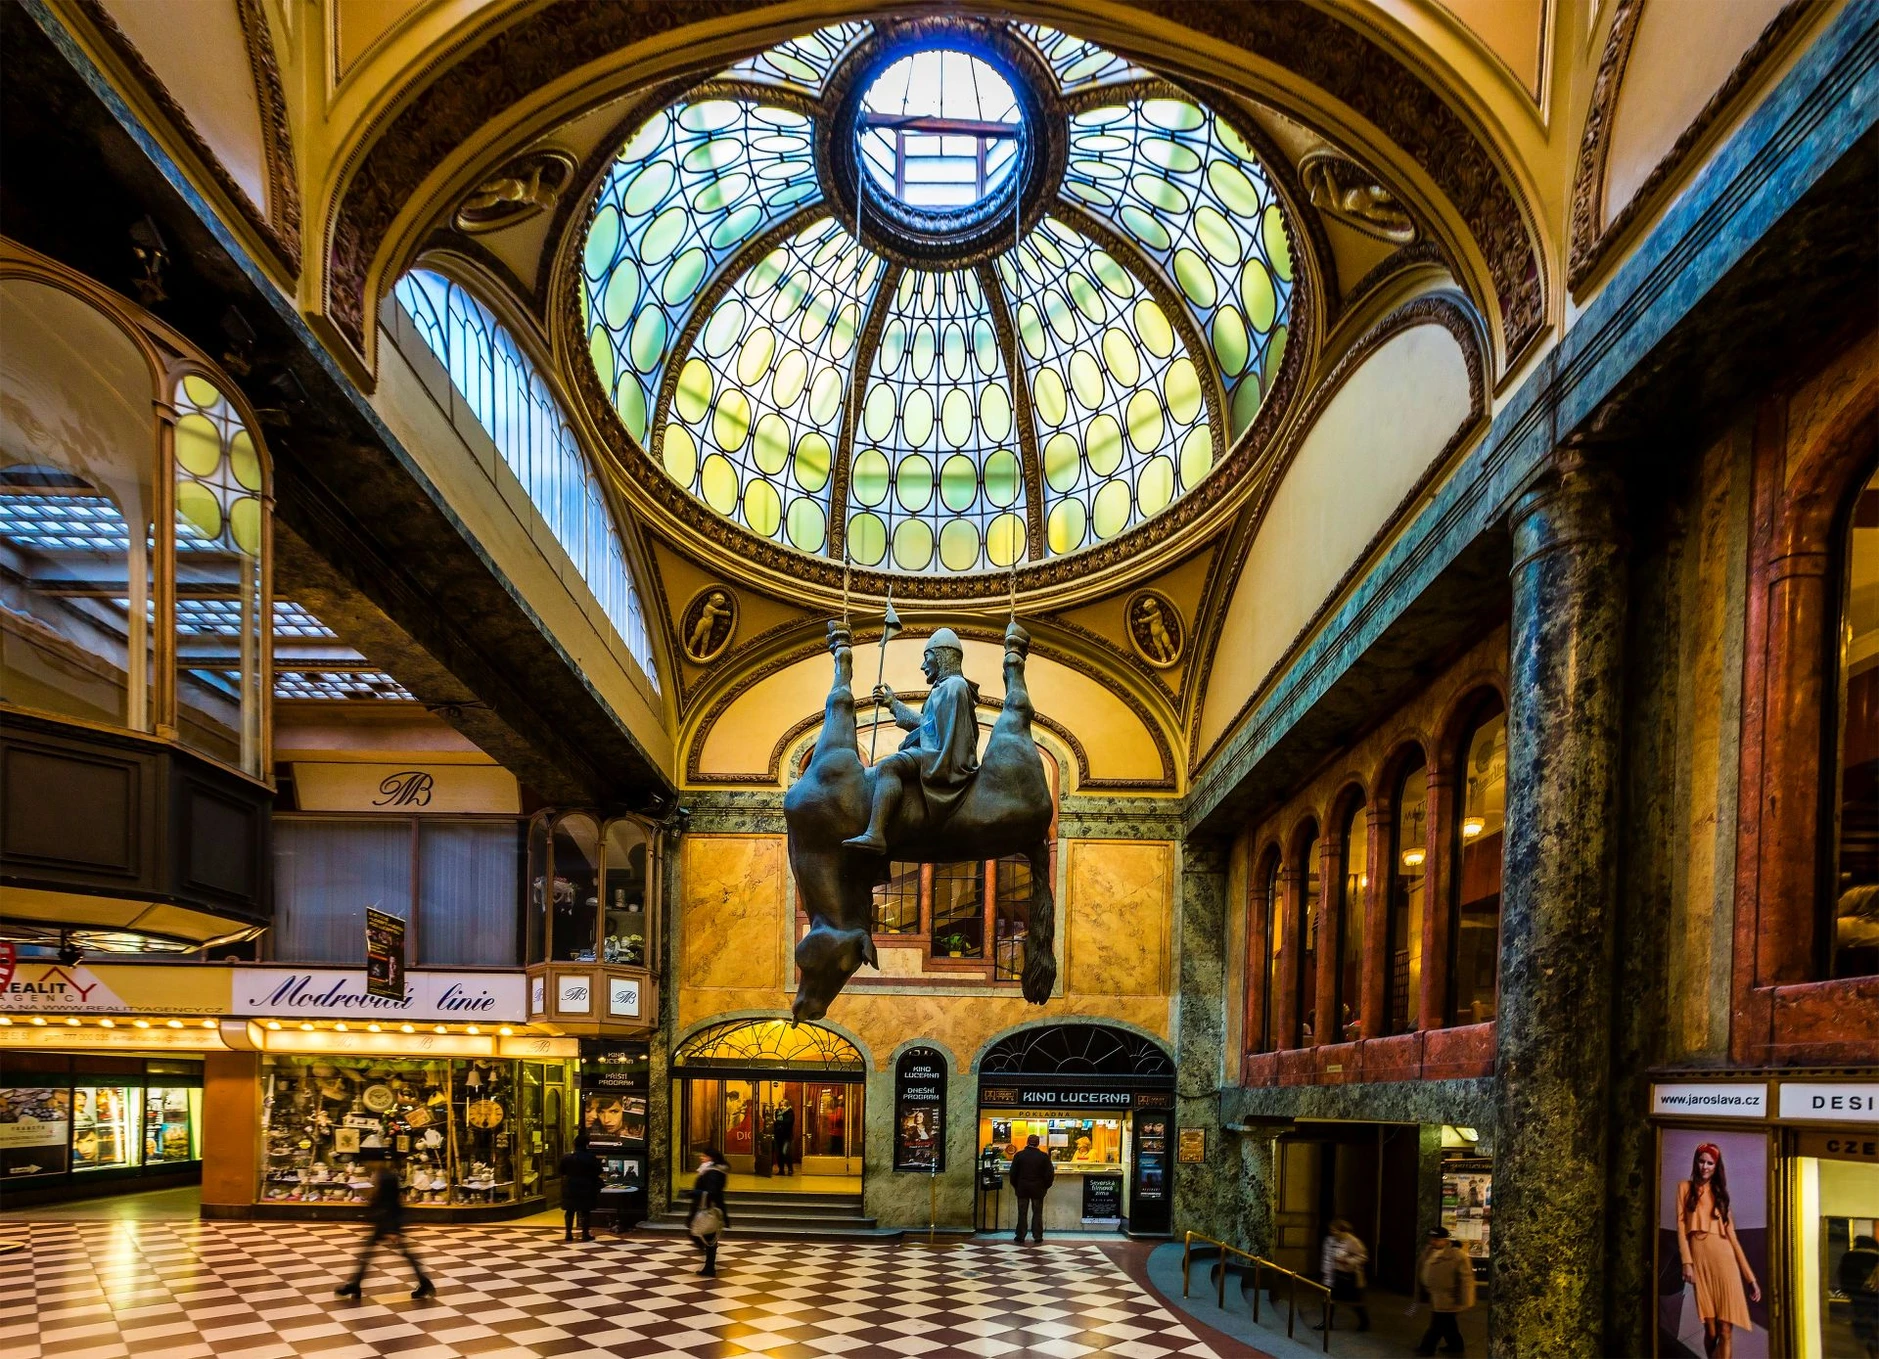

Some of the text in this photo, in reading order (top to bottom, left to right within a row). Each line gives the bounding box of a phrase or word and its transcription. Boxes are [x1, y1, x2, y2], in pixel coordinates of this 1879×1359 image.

[436, 983, 496, 1012] linie
[43, 1004, 223, 1013] WWW.REALITYAGENCY.CZ
[1023, 1092, 1056, 1102] KINO
[1060, 1093, 1130, 1103] LUCERNA
[1660, 1094, 1760, 1106] www.jaroslava.cz
[1812, 1096, 1873, 1110] DESI
[1827, 1140, 1876, 1155] CZE
